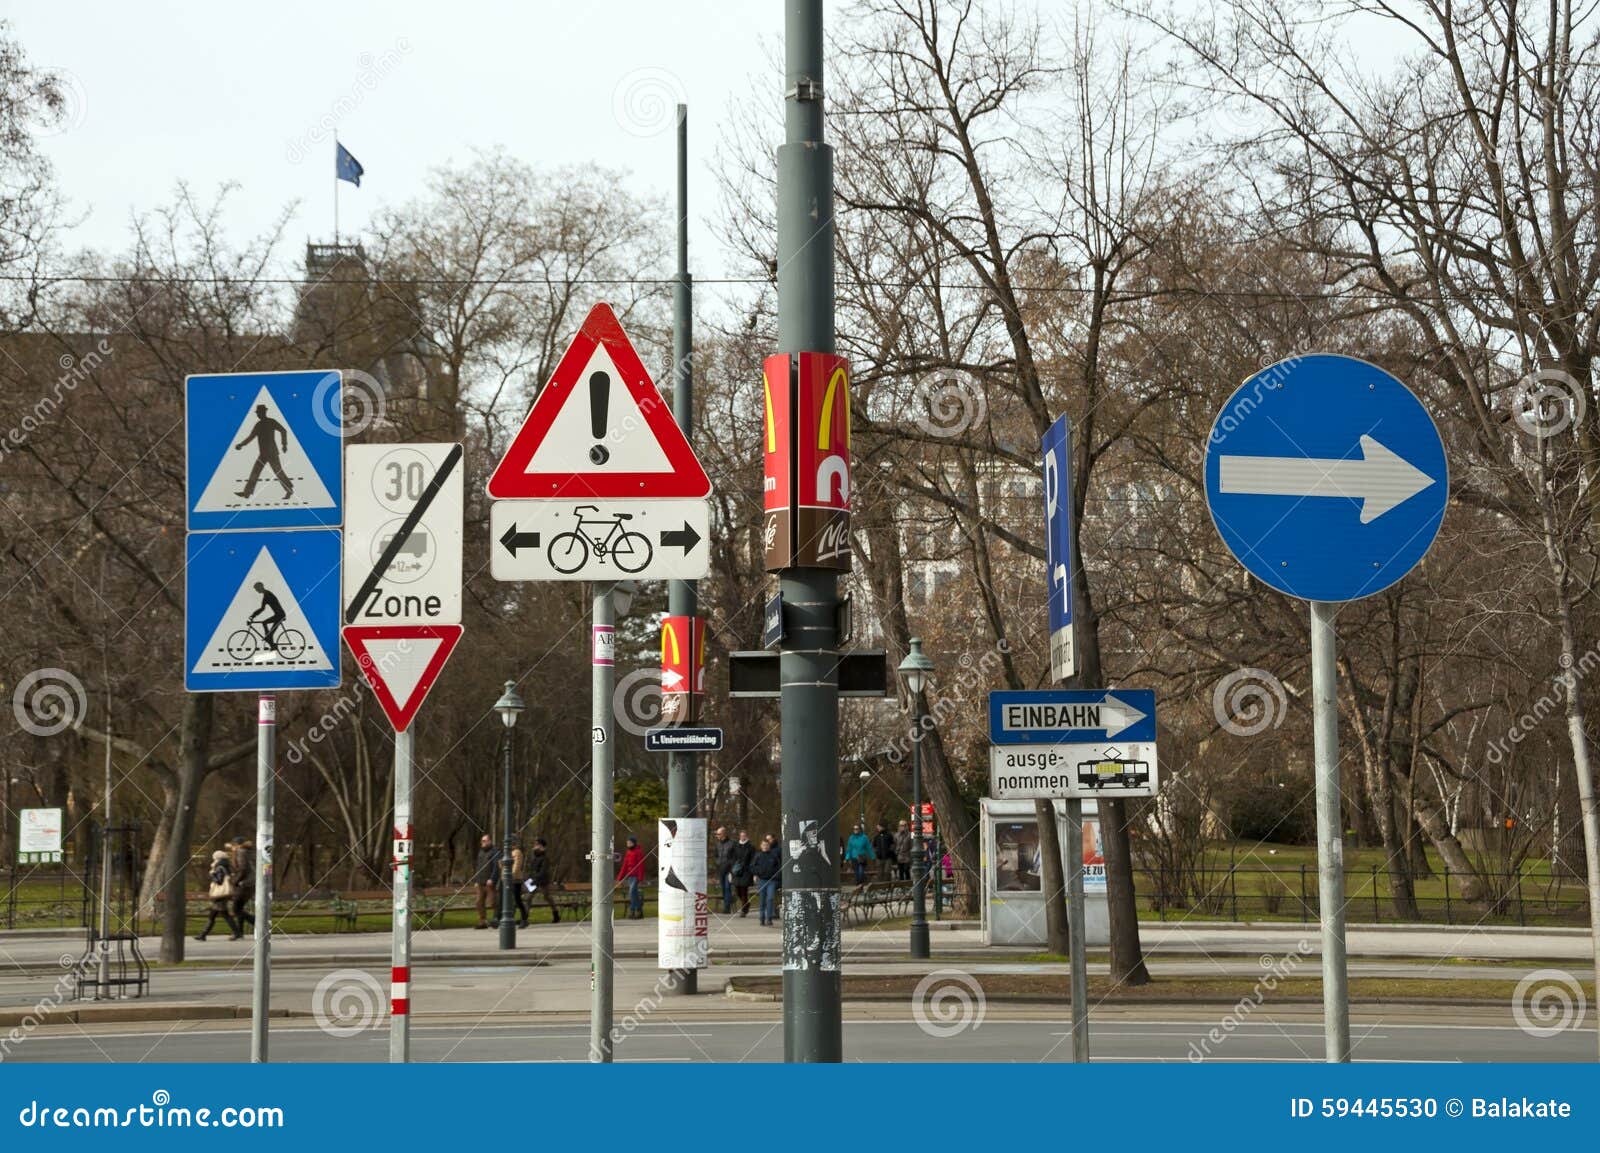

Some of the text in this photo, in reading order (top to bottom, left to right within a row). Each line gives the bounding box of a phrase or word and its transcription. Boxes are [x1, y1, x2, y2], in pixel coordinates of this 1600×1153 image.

[385, 462, 424, 501] 30
[364, 588, 442, 618] Zone
[1008, 705, 1100, 728] EINBAHN
[1006, 752, 1064, 770] ausge-
[999, 774, 1069, 789] nommen
[694, 891, 708, 937] ASIEN
